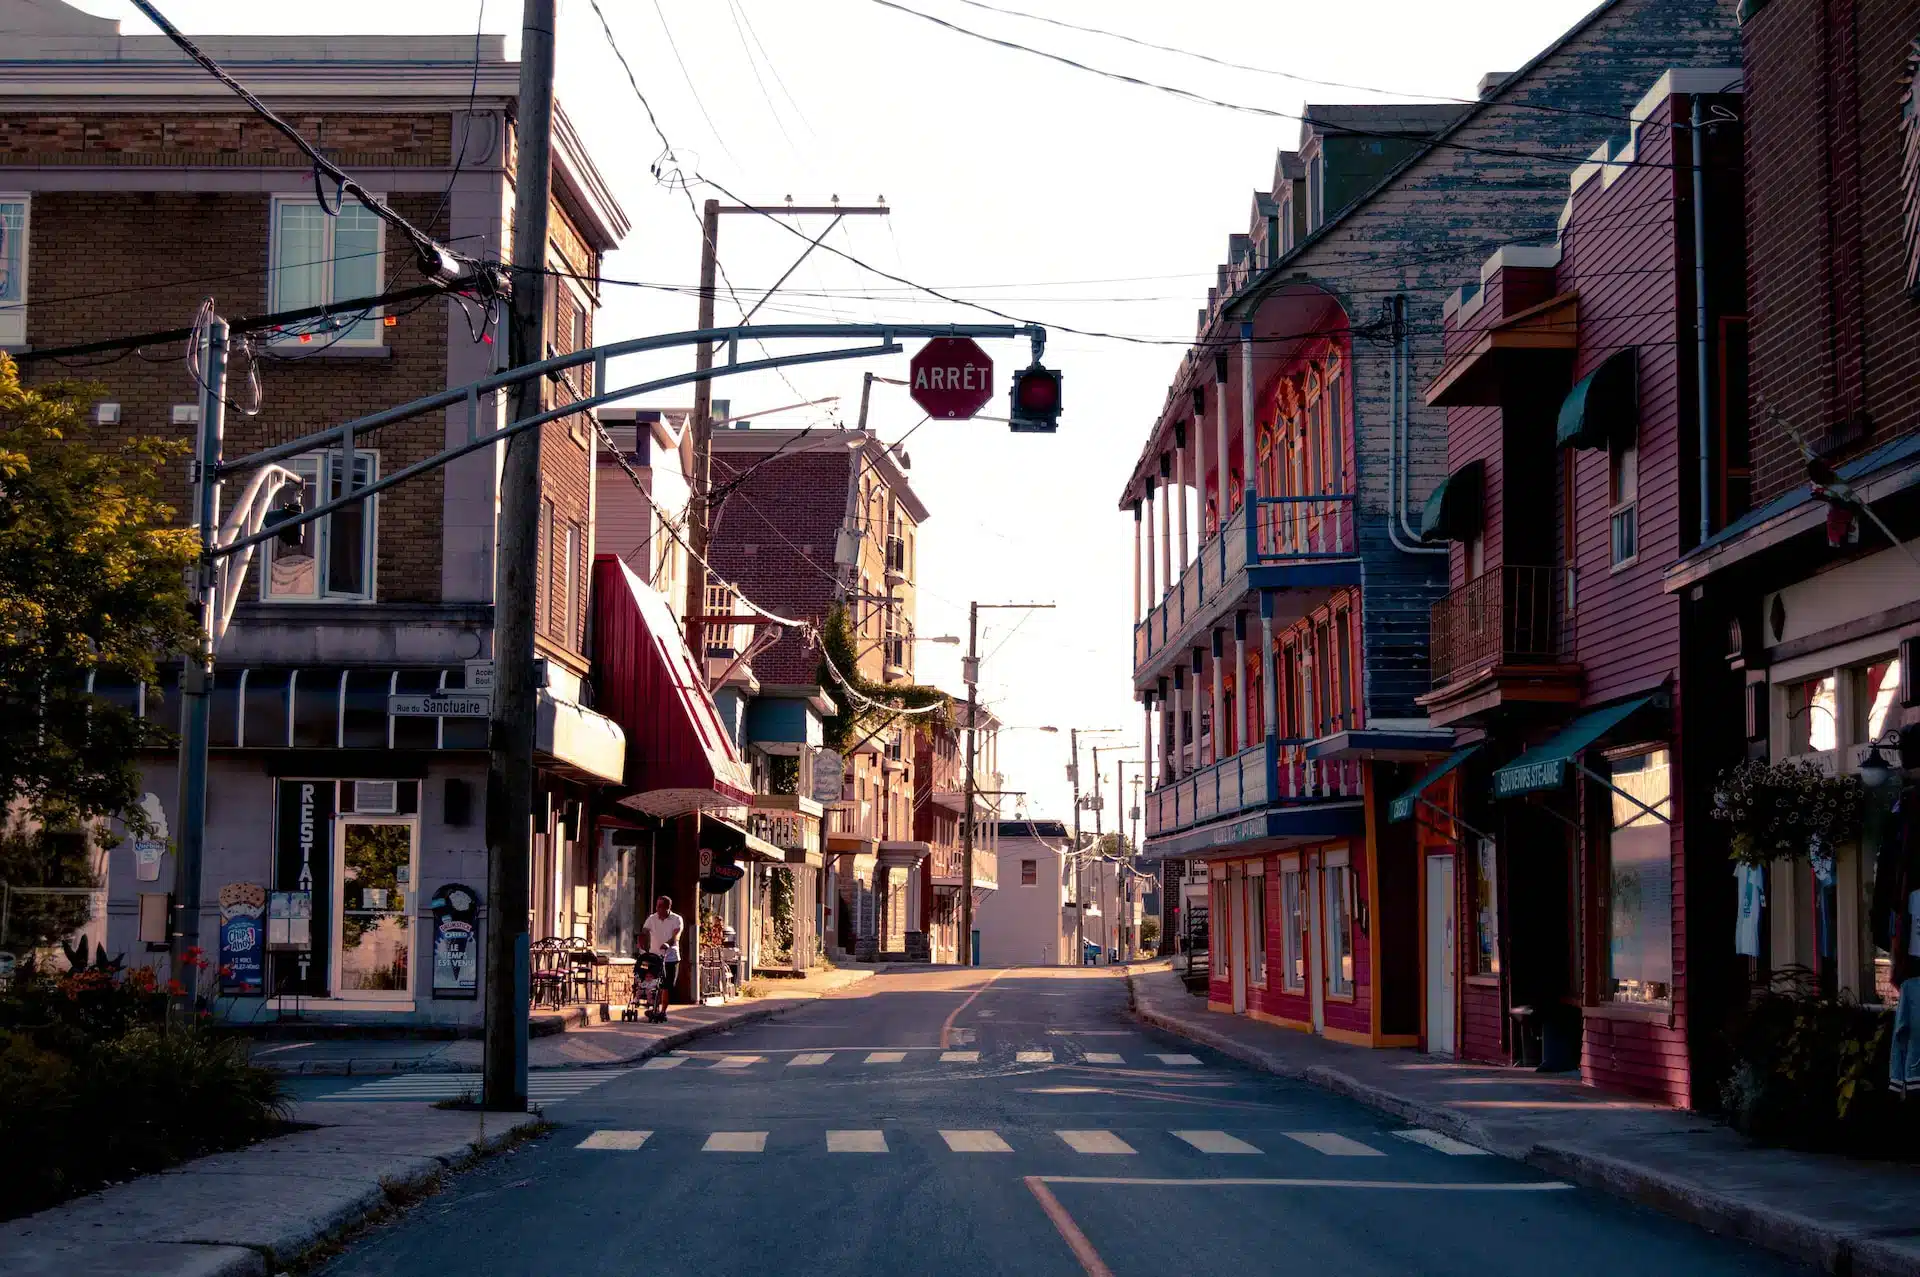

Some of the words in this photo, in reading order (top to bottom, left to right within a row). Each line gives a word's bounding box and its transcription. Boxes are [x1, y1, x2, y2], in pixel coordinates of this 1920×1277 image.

[914, 363, 990, 390] ARRÊT
[396, 704, 410, 712] Rue
[411, 704, 420, 712] du
[423, 699, 480, 713] Sanctuaire
[228, 929, 250, 943] Chips
[450, 943, 459, 951] LE
[443, 951, 468, 959] TEMPS
[438, 959, 451, 967] EST
[452, 959, 473, 967] VENU
